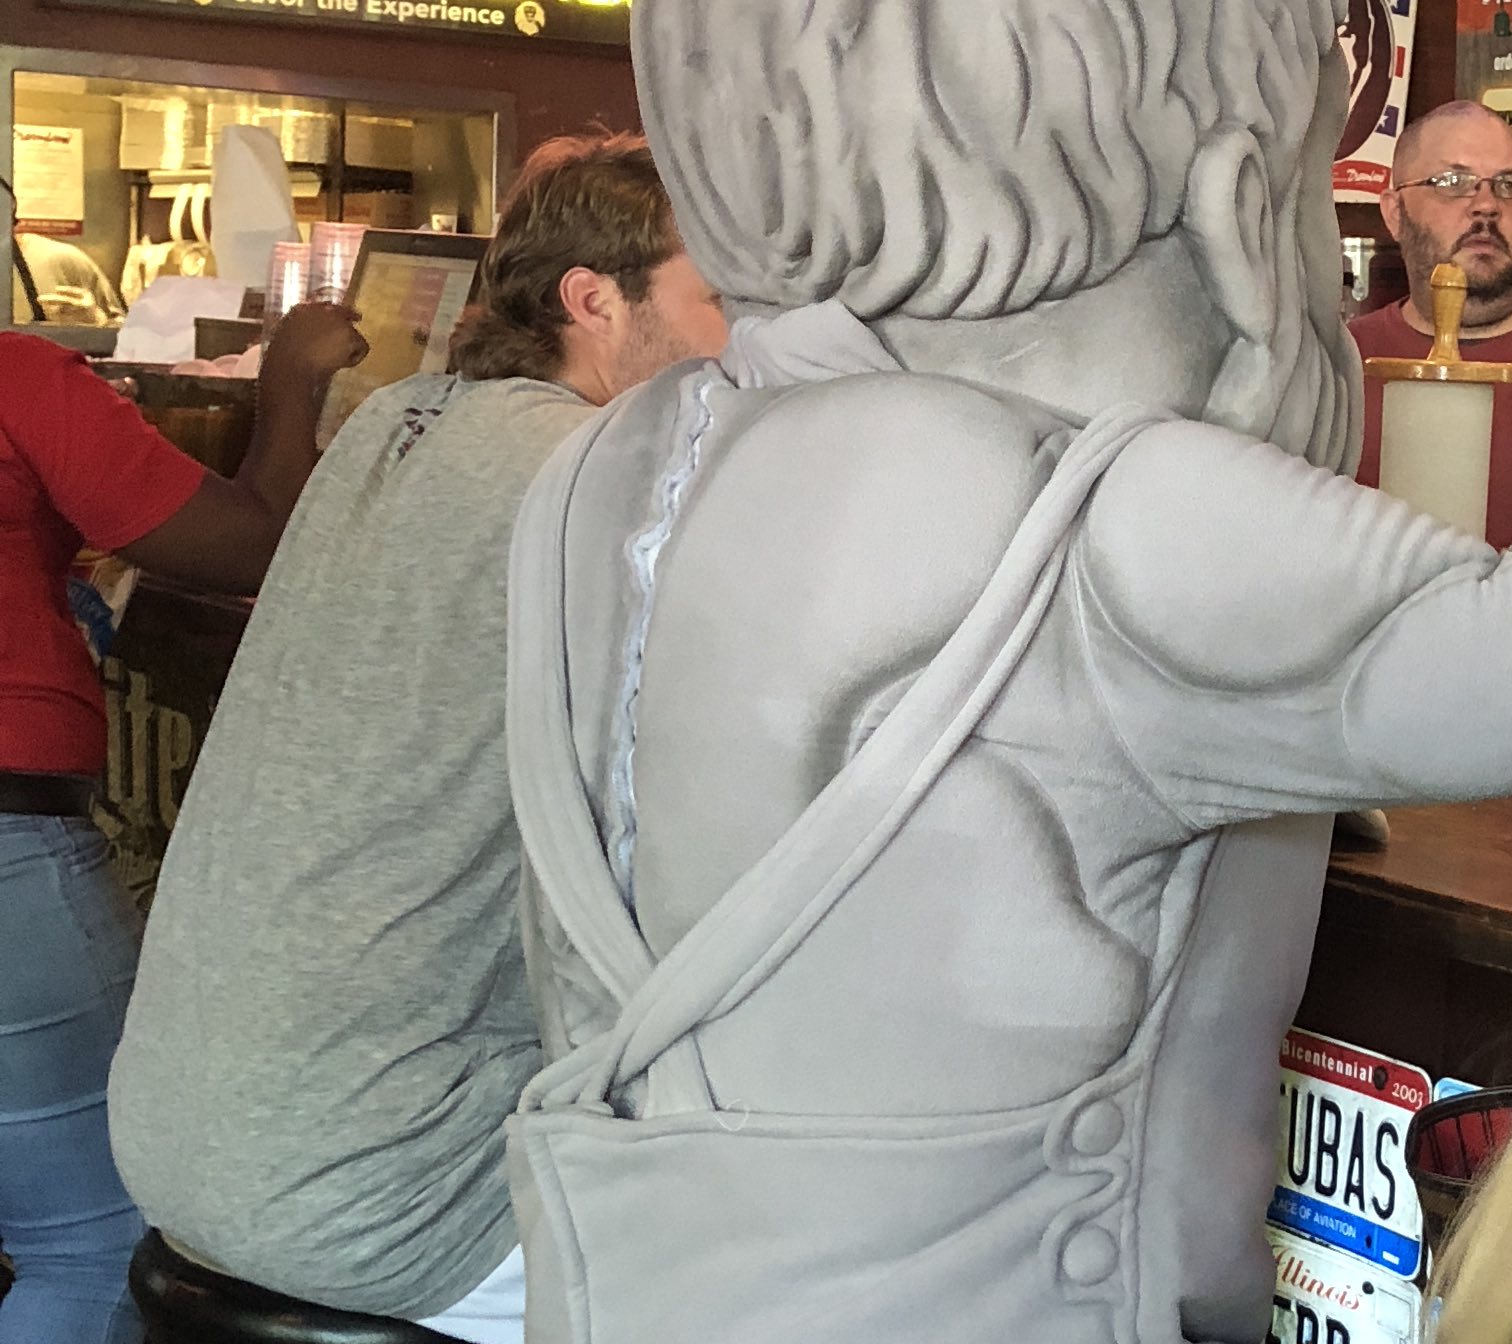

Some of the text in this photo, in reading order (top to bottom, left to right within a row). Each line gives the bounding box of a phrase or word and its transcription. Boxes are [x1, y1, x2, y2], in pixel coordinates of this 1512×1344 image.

[1281, 1036, 1425, 1110] Bicentennial 2003
[1286, 1086, 1400, 1221] UBAS
[1299, 1202, 1358, 1240] OF AVIATION
[1273, 1243, 1362, 1312] Illinois
